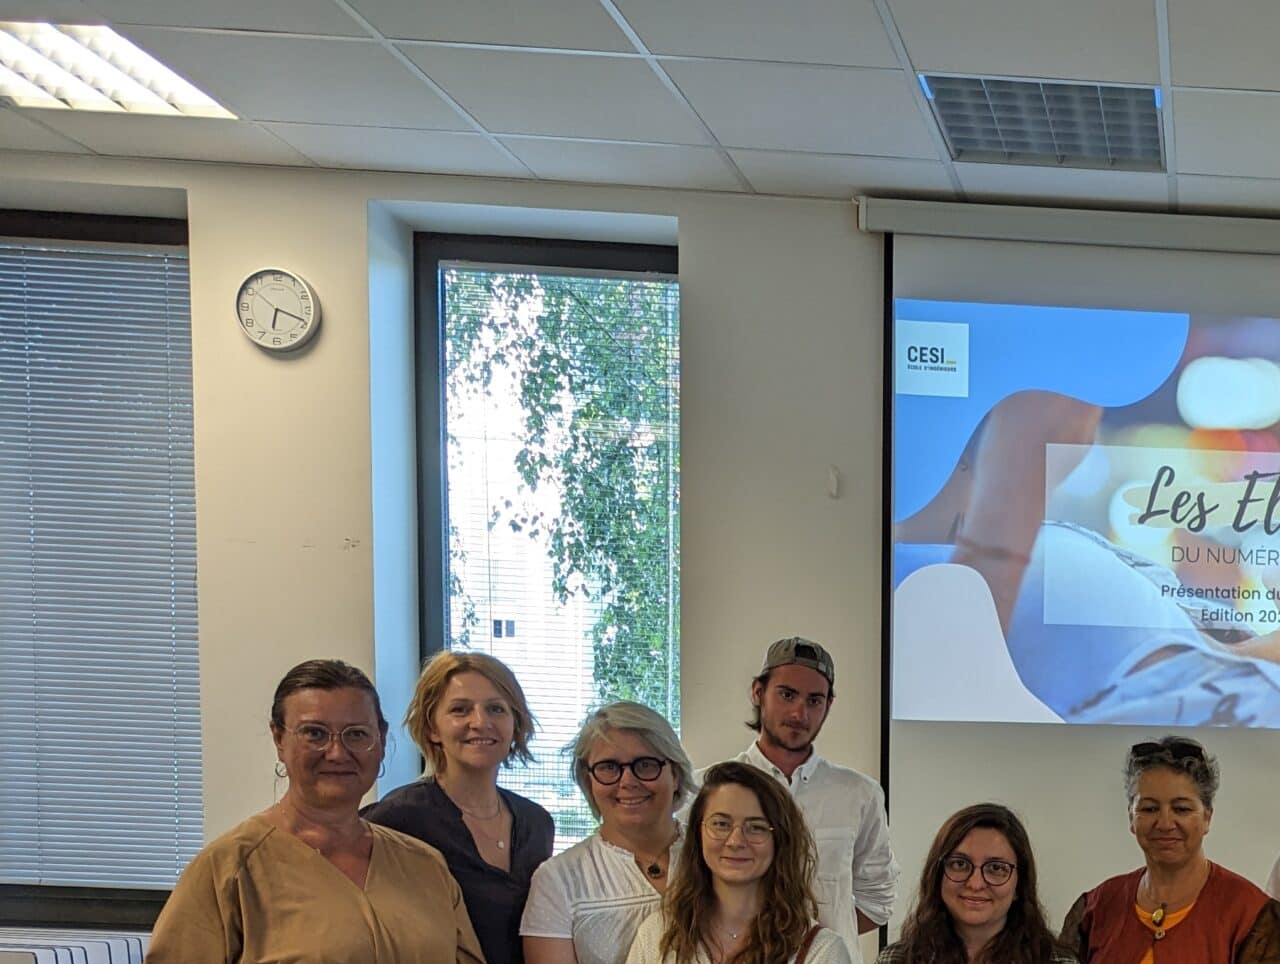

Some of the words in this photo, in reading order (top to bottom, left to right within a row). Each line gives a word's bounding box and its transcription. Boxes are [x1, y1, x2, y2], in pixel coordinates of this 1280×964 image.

[907, 345, 945, 364] CESI
[1138, 465, 1220, 533] Les
[1171, 546, 1200, 563] DU
[1161, 584, 1261, 601] Présentation
[1201, 608, 1254, 623] Edition
